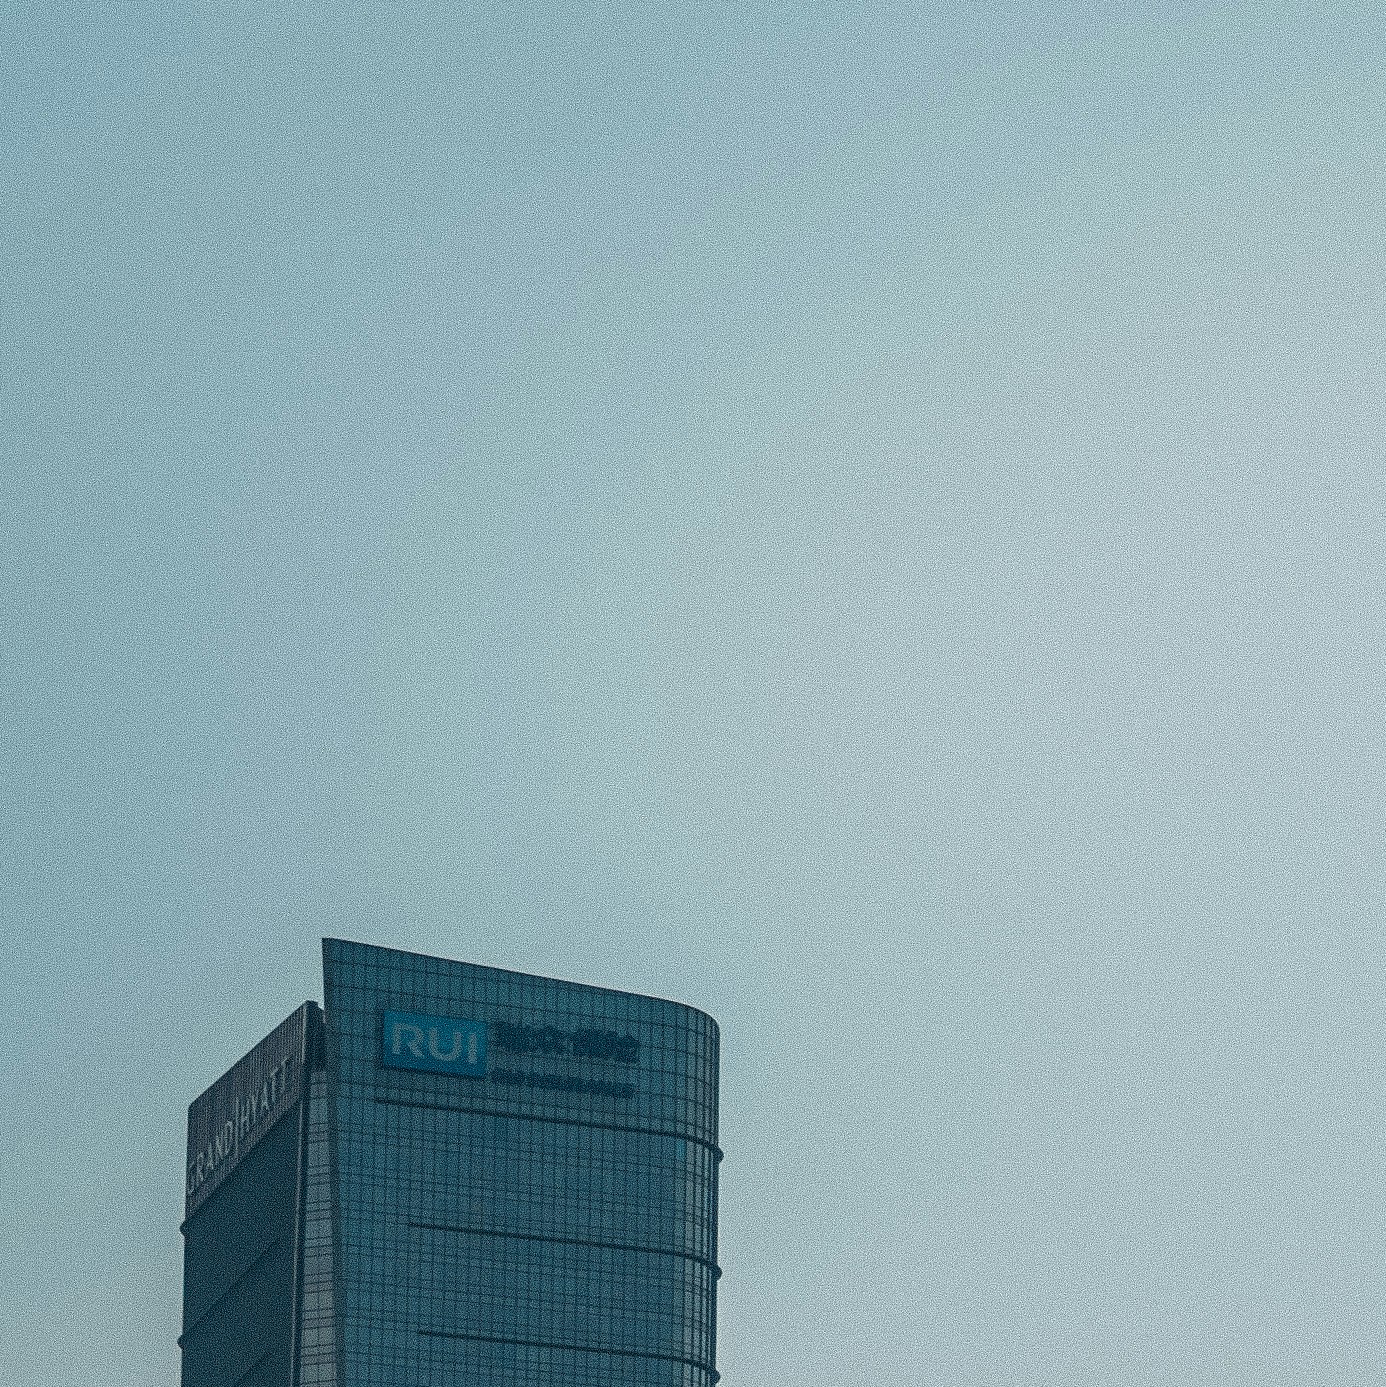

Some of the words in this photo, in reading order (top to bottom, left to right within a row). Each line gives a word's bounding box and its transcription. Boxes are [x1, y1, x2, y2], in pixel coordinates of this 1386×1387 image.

[390, 1021, 478, 1065] RUI
[187, 1119, 235, 1197] GRAND
[239, 1055, 291, 1137] HYATT
